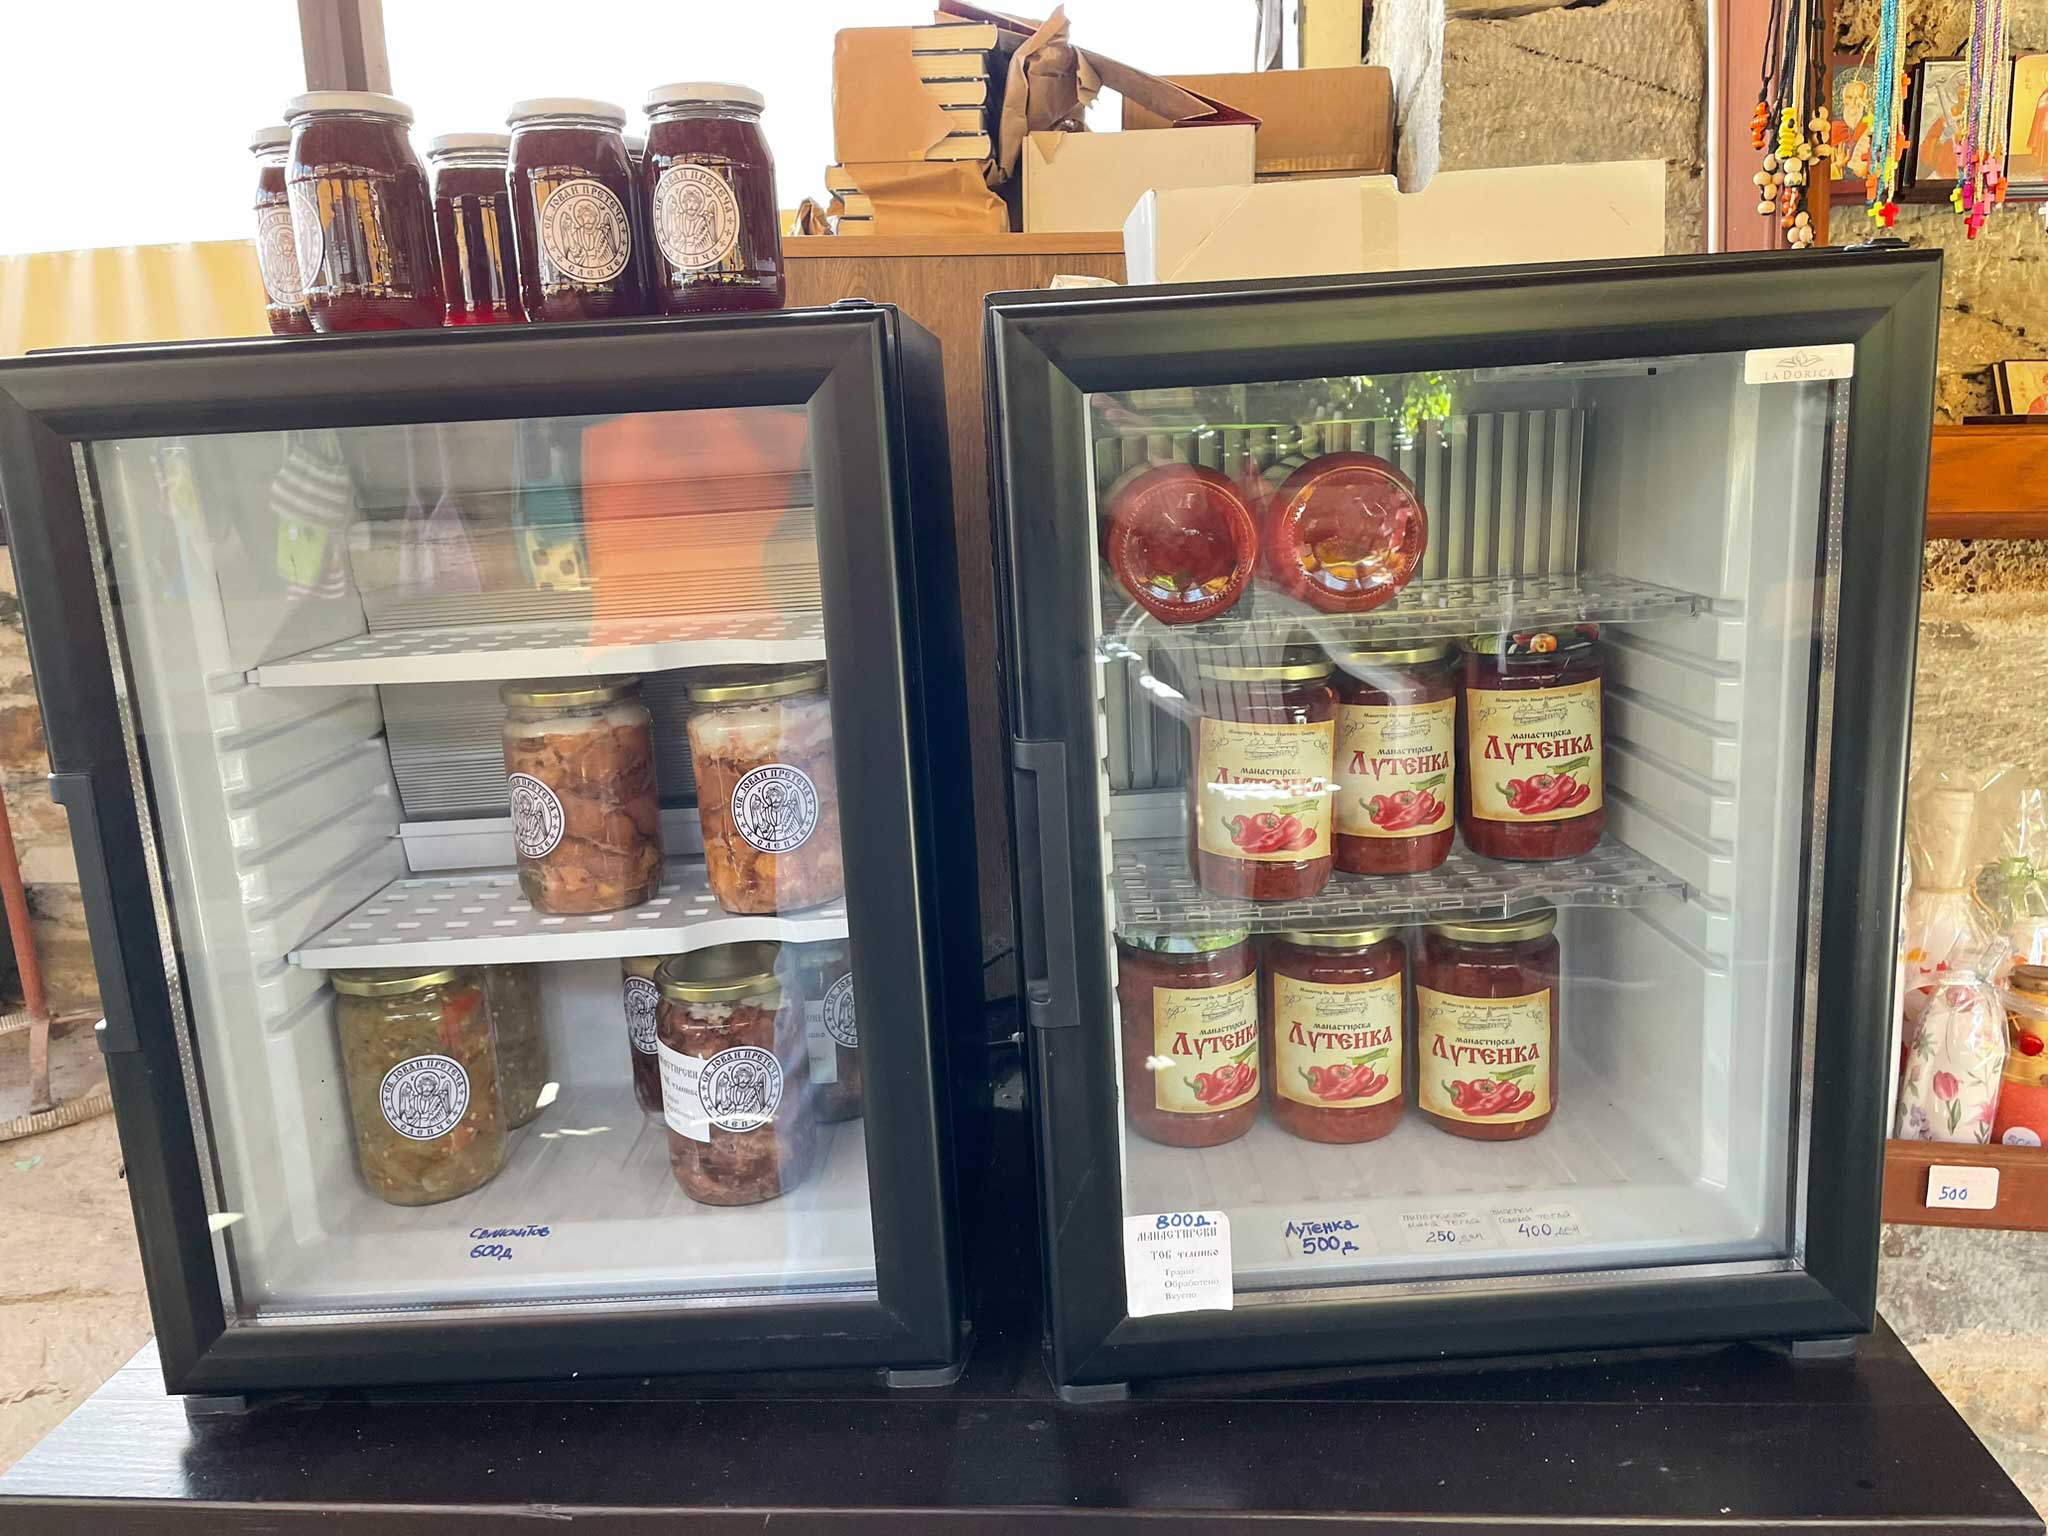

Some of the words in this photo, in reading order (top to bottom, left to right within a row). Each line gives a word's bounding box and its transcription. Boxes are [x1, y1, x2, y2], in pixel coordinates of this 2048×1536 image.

[582, 185, 624, 224] ПРЕТЕЧА
[1764, 371, 1778, 381] LA
[1783, 368, 1835, 380] DORICA
[743, 770, 768, 794] ЈОВАН
[771, 769, 811, 796] ПРЕТЕЧА
[711, 1051, 740, 1069] ЈОВАН
[393, 1061, 423, 1080] ЈОВАН
[426, 1060, 464, 1088] ПРЕТЕЧА
[1938, 1185, 1968, 1201] 500
[1426, 1230, 1456, 1243] 250
[1518, 1223, 1552, 1238] 400
